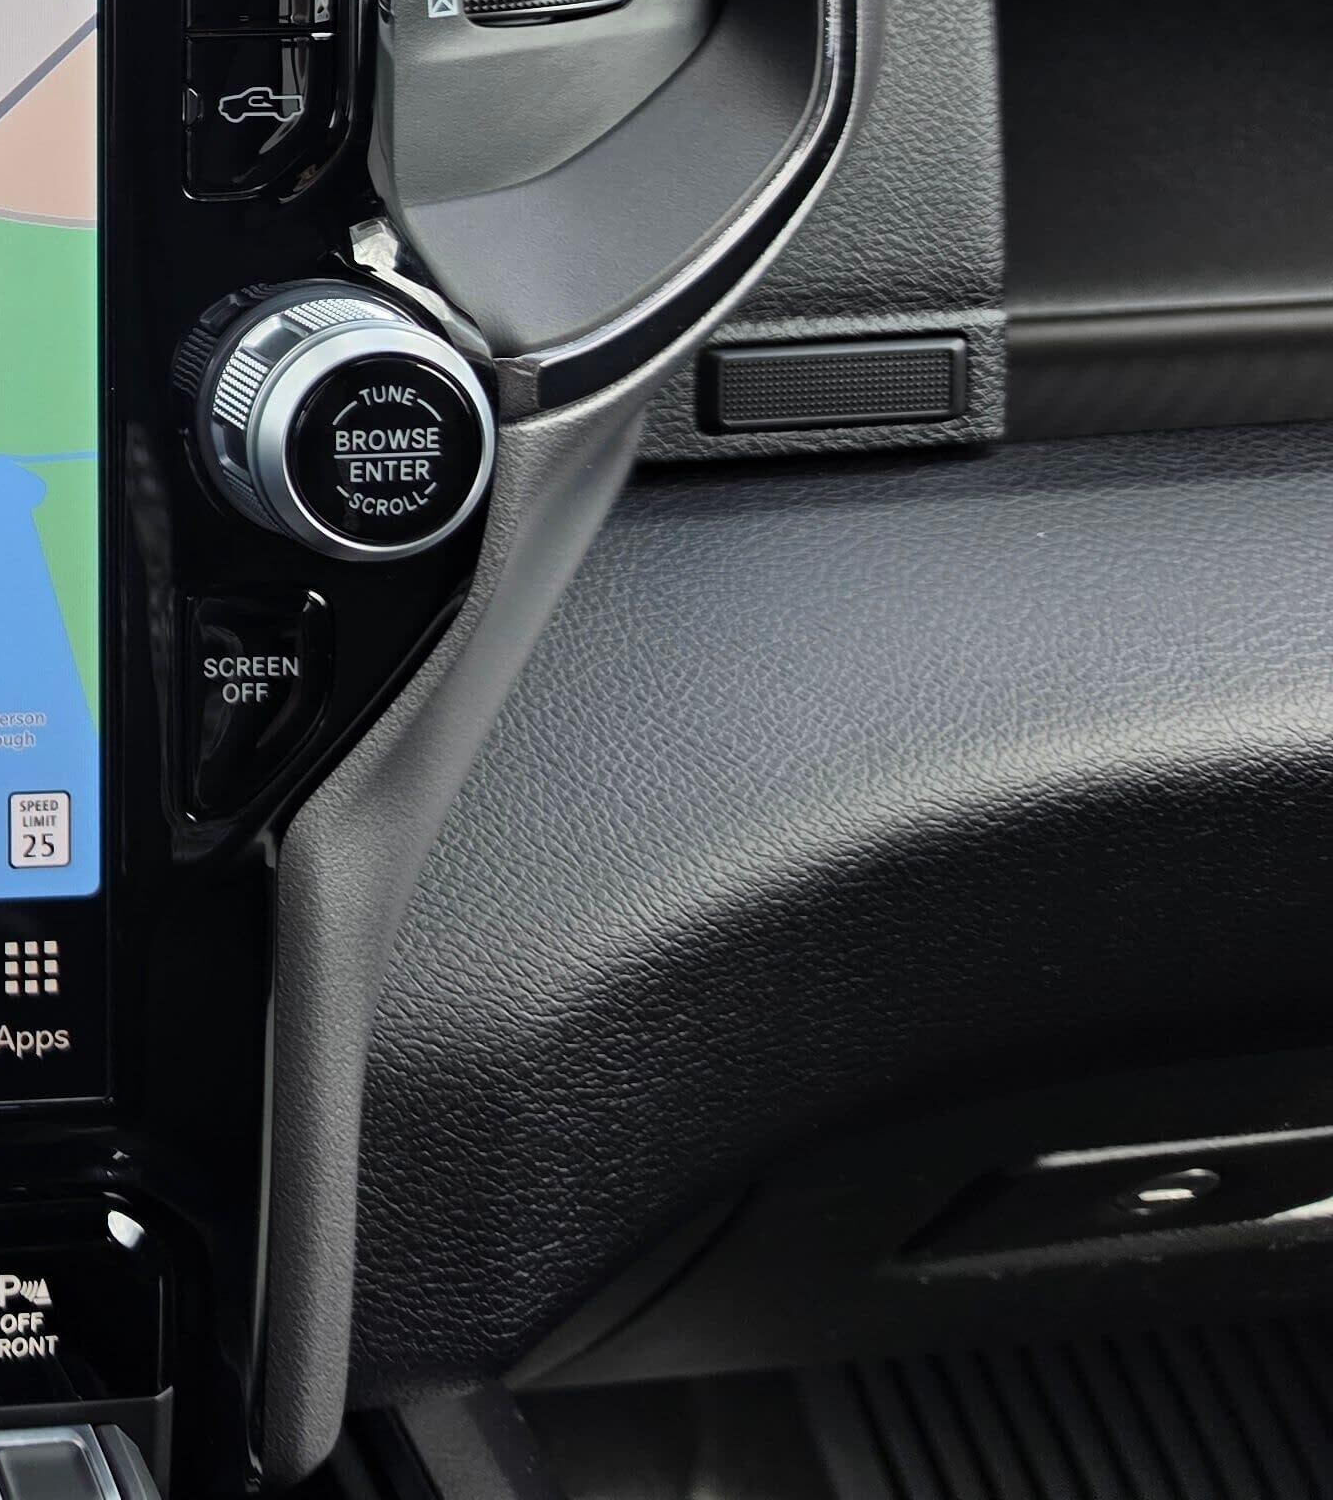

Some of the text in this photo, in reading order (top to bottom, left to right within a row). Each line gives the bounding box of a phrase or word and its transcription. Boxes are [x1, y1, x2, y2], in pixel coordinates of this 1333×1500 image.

[359, 385, 418, 408] TUNE
[335, 427, 440, 453] BROWSE
[349, 459, 431, 484] ENTER
[348, 490, 430, 517] SCROLL
[202, 657, 300, 678] SCREEN
[222, 683, 269, 704] OFF
[19, 800, 59, 812] SPEED
[22, 815, 58, 828] LIMIT
[22, 833, 56, 858] 25
[0, 1311, 44, 1335] OFF
